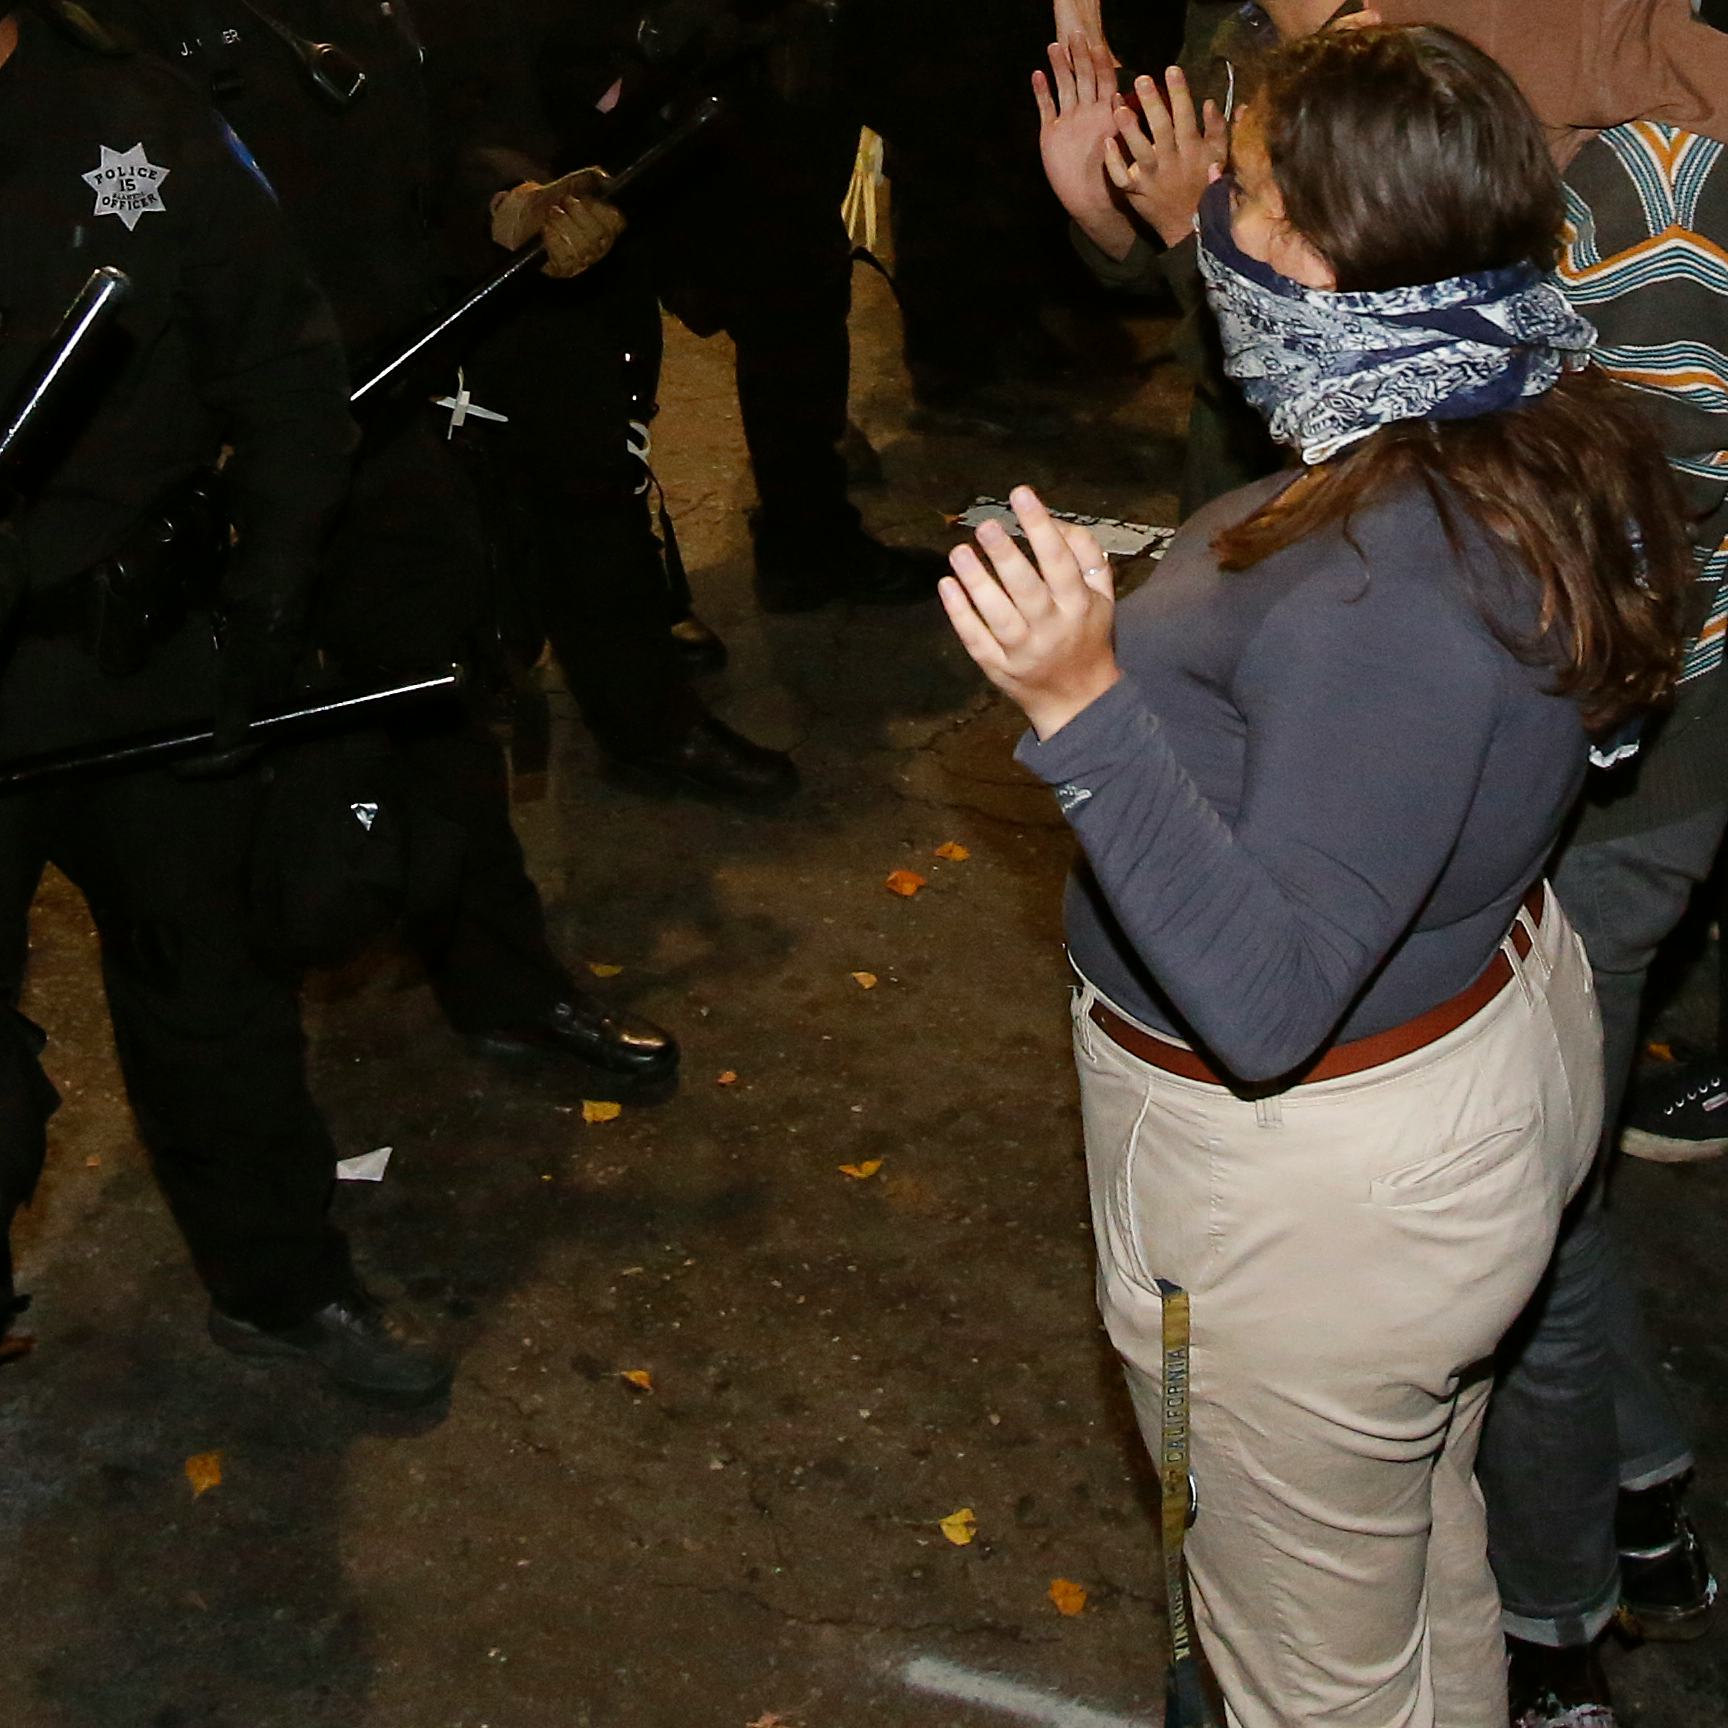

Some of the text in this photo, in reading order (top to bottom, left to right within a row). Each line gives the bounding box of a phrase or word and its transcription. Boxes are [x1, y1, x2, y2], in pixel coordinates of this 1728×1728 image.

[94, 167, 158, 184] POLICE
[121, 180, 136, 192] 15
[102, 193, 157, 212] OFFICER
[1166, 1349, 1185, 1464] CALIFORNIA
